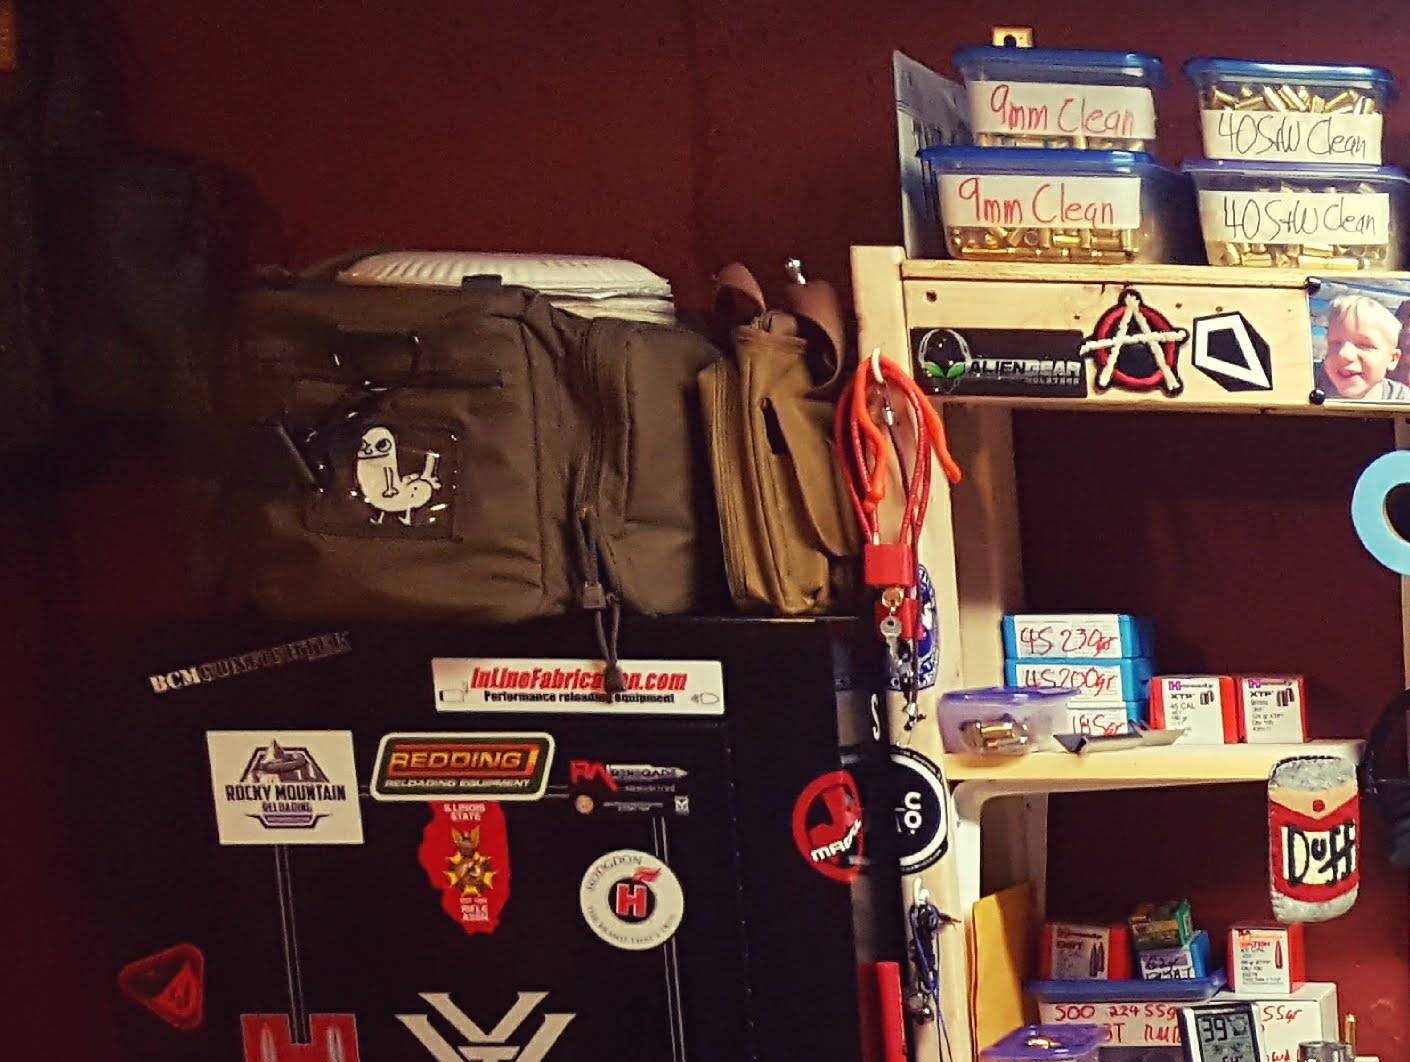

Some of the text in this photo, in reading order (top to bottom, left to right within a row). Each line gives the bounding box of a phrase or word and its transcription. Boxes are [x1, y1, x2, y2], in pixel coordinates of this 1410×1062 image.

[990, 84, 1134, 137] 9mm Clean
[1307, 121, 1367, 158] Clean
[958, 176, 1114, 225] 9mm Clean
[1323, 198, 1375, 238] Clean
[1021, 627, 1053, 656] 45
[390, 751, 522, 769] REDDING
[225, 784, 346, 800] ROCKY MOUNTAIN
[1282, 823, 1359, 886] Duff
[1202, 1017, 1228, 1043] 39
